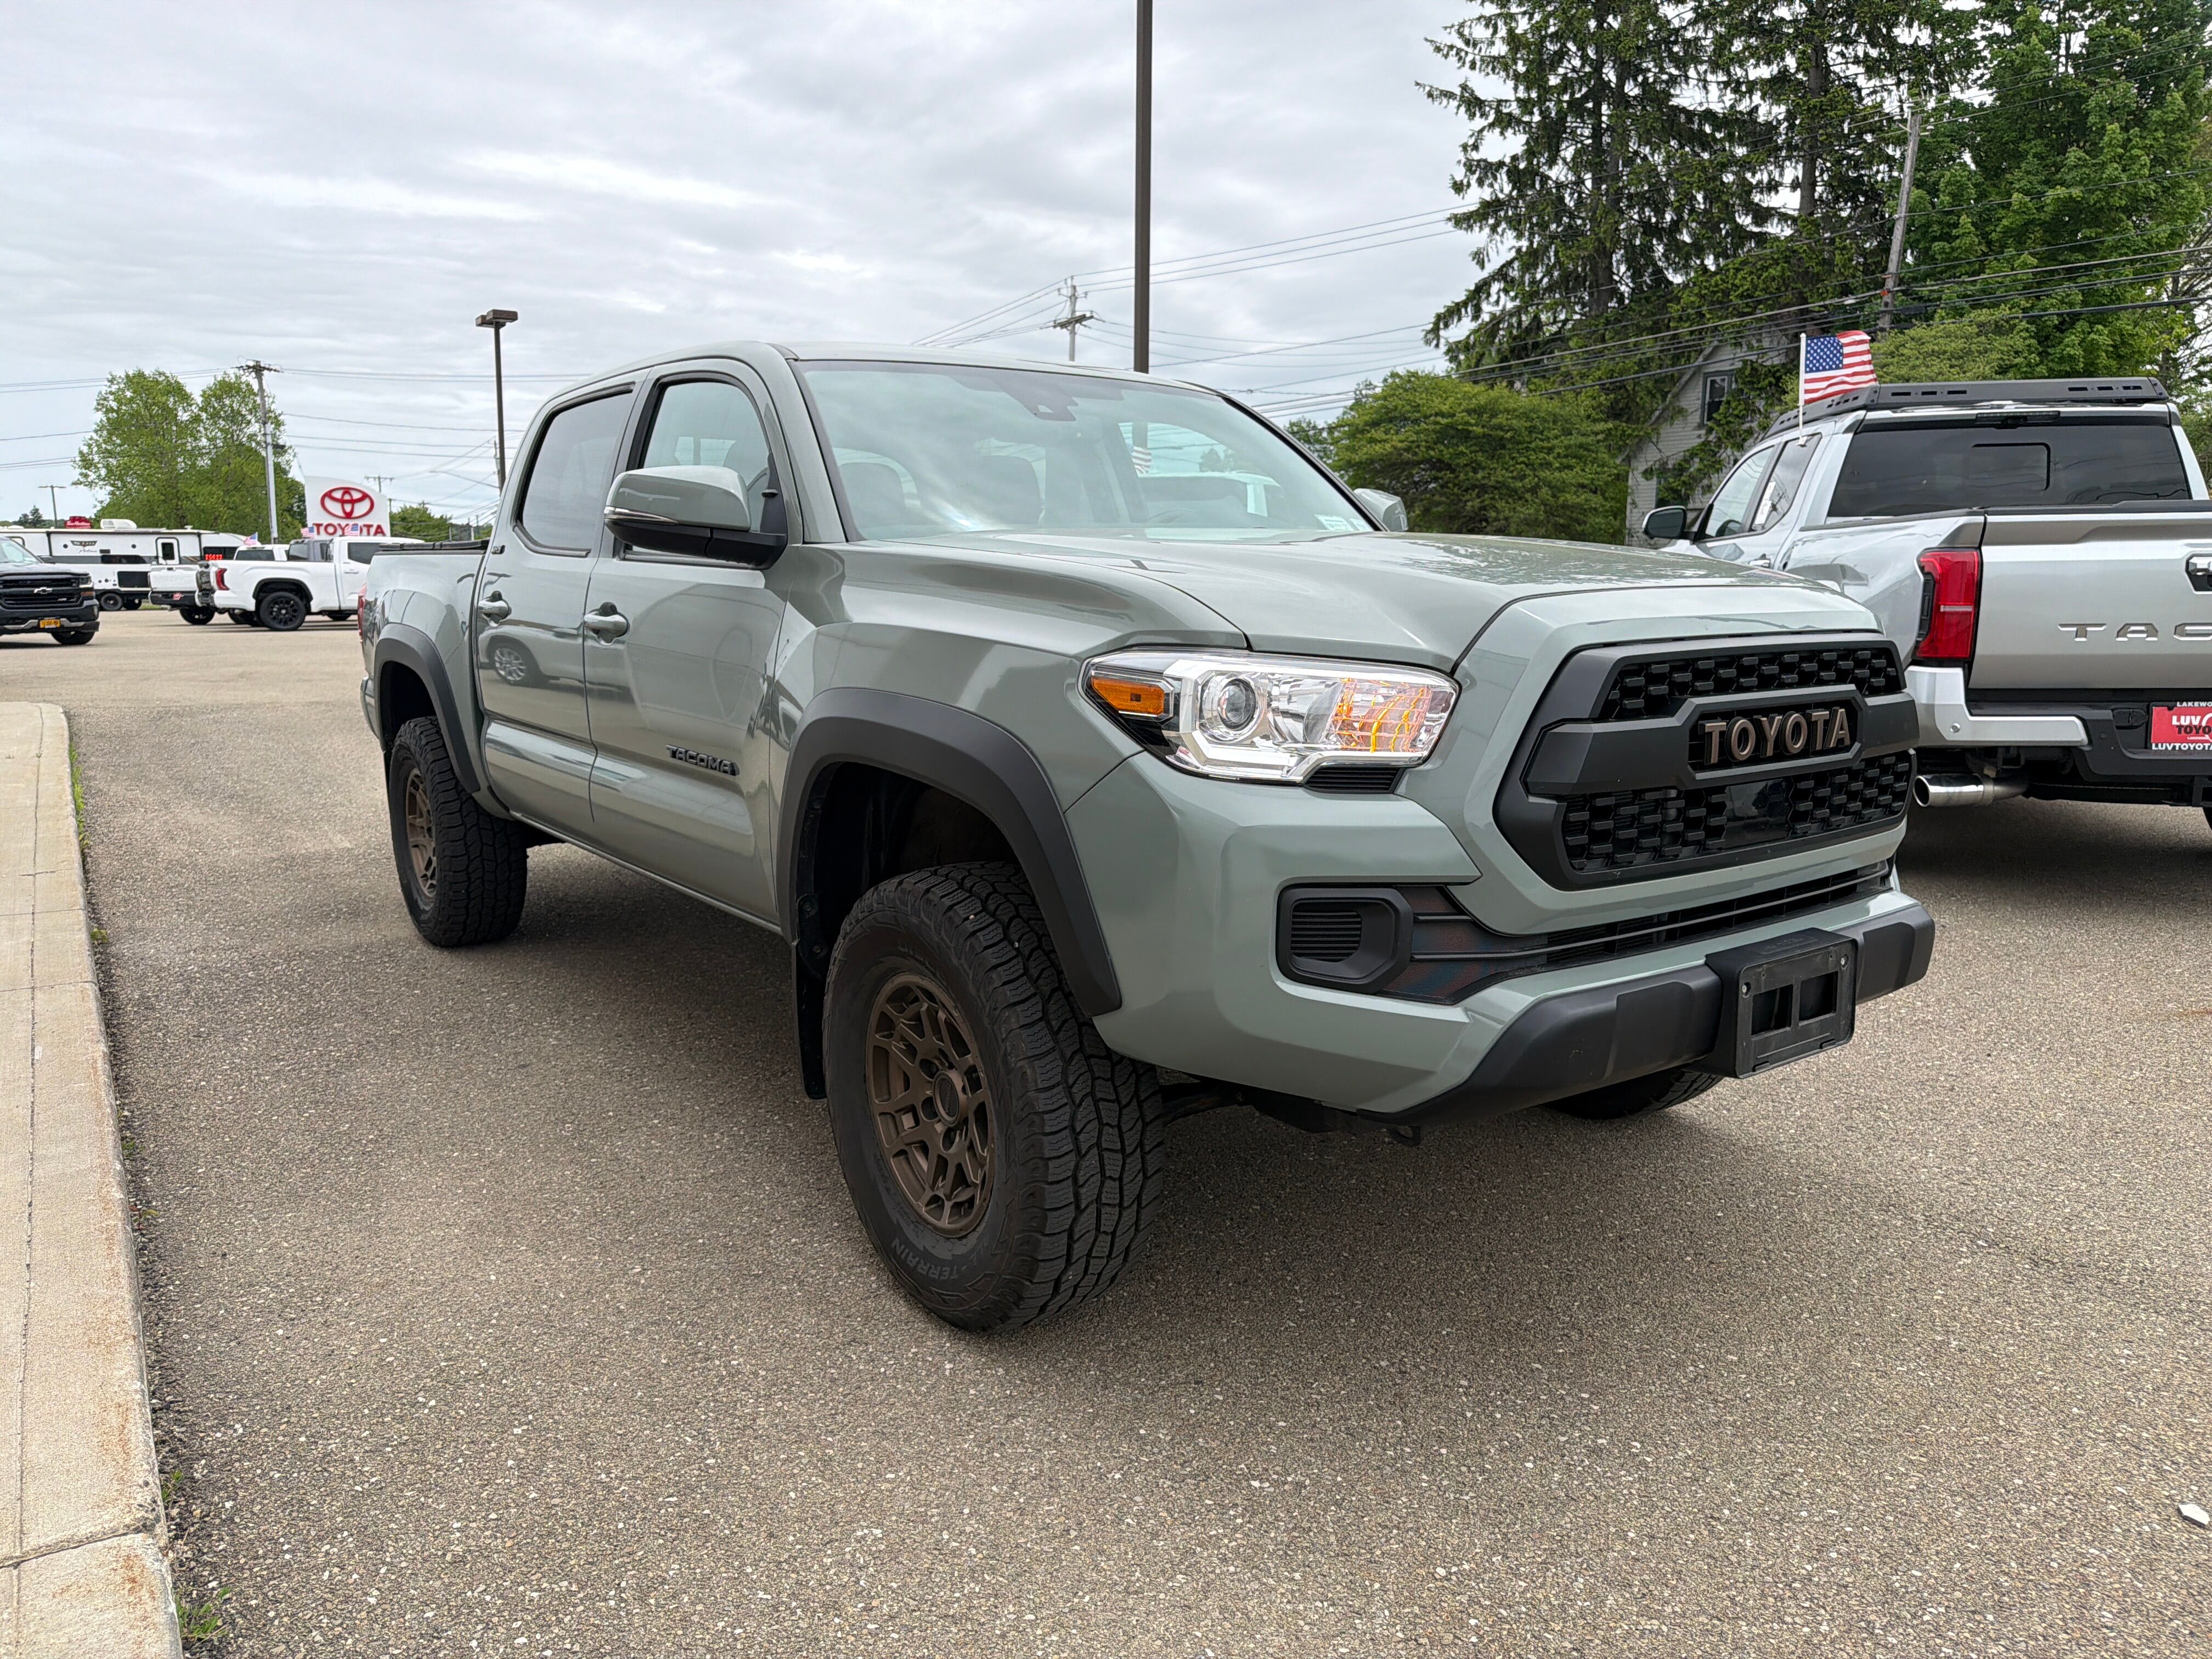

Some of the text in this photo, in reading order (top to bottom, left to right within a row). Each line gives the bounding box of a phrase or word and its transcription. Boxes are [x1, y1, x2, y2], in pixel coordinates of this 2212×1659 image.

[2172, 715, 2201, 725] LUV
[2176, 725, 2212, 735] TOYO
[1701, 708, 1850, 765] TOYOTA
[665, 744, 740, 776] TACOMA
